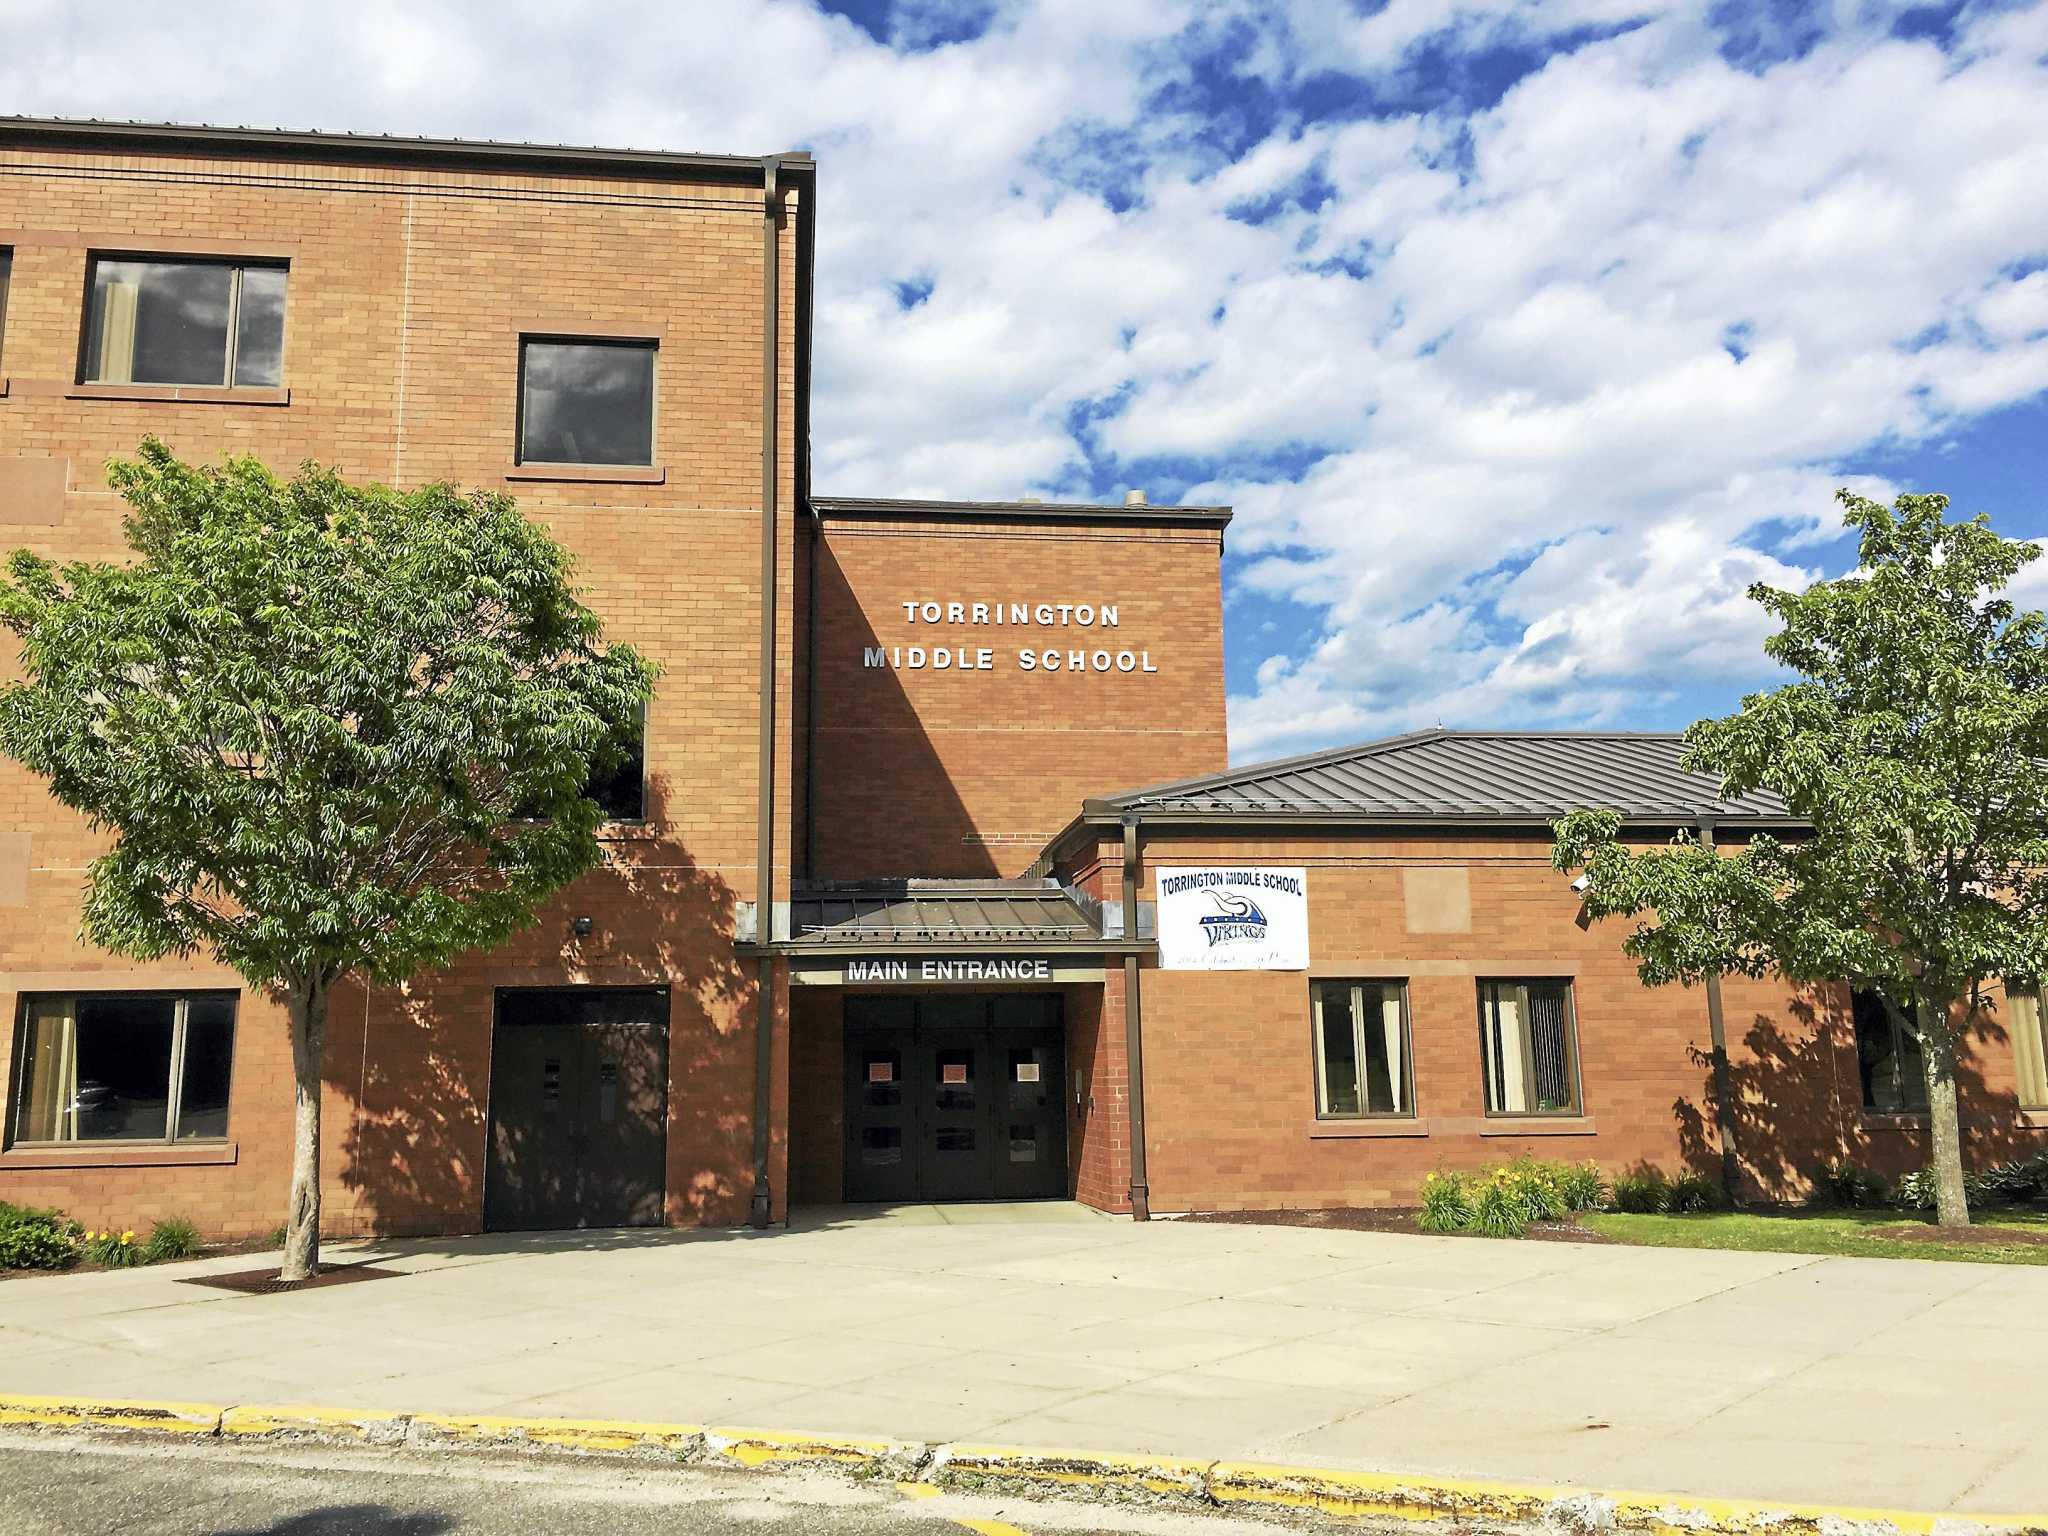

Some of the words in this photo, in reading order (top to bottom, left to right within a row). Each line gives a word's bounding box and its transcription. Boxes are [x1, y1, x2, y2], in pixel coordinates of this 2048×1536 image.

[903, 602, 1119, 626] TORRINGTON
[864, 647, 994, 670] MIDDLE
[1018, 649, 1158, 672] SCHOOL
[1162, 872, 1223, 896] TORRINGTON
[1225, 872, 1260, 886] MIDDLE
[1264, 874, 1302, 896] SCHOOL
[1203, 924, 1265, 947] VIKINGS
[848, 961, 907, 980] MAIN
[922, 960, 1049, 979] ENTRANCE
